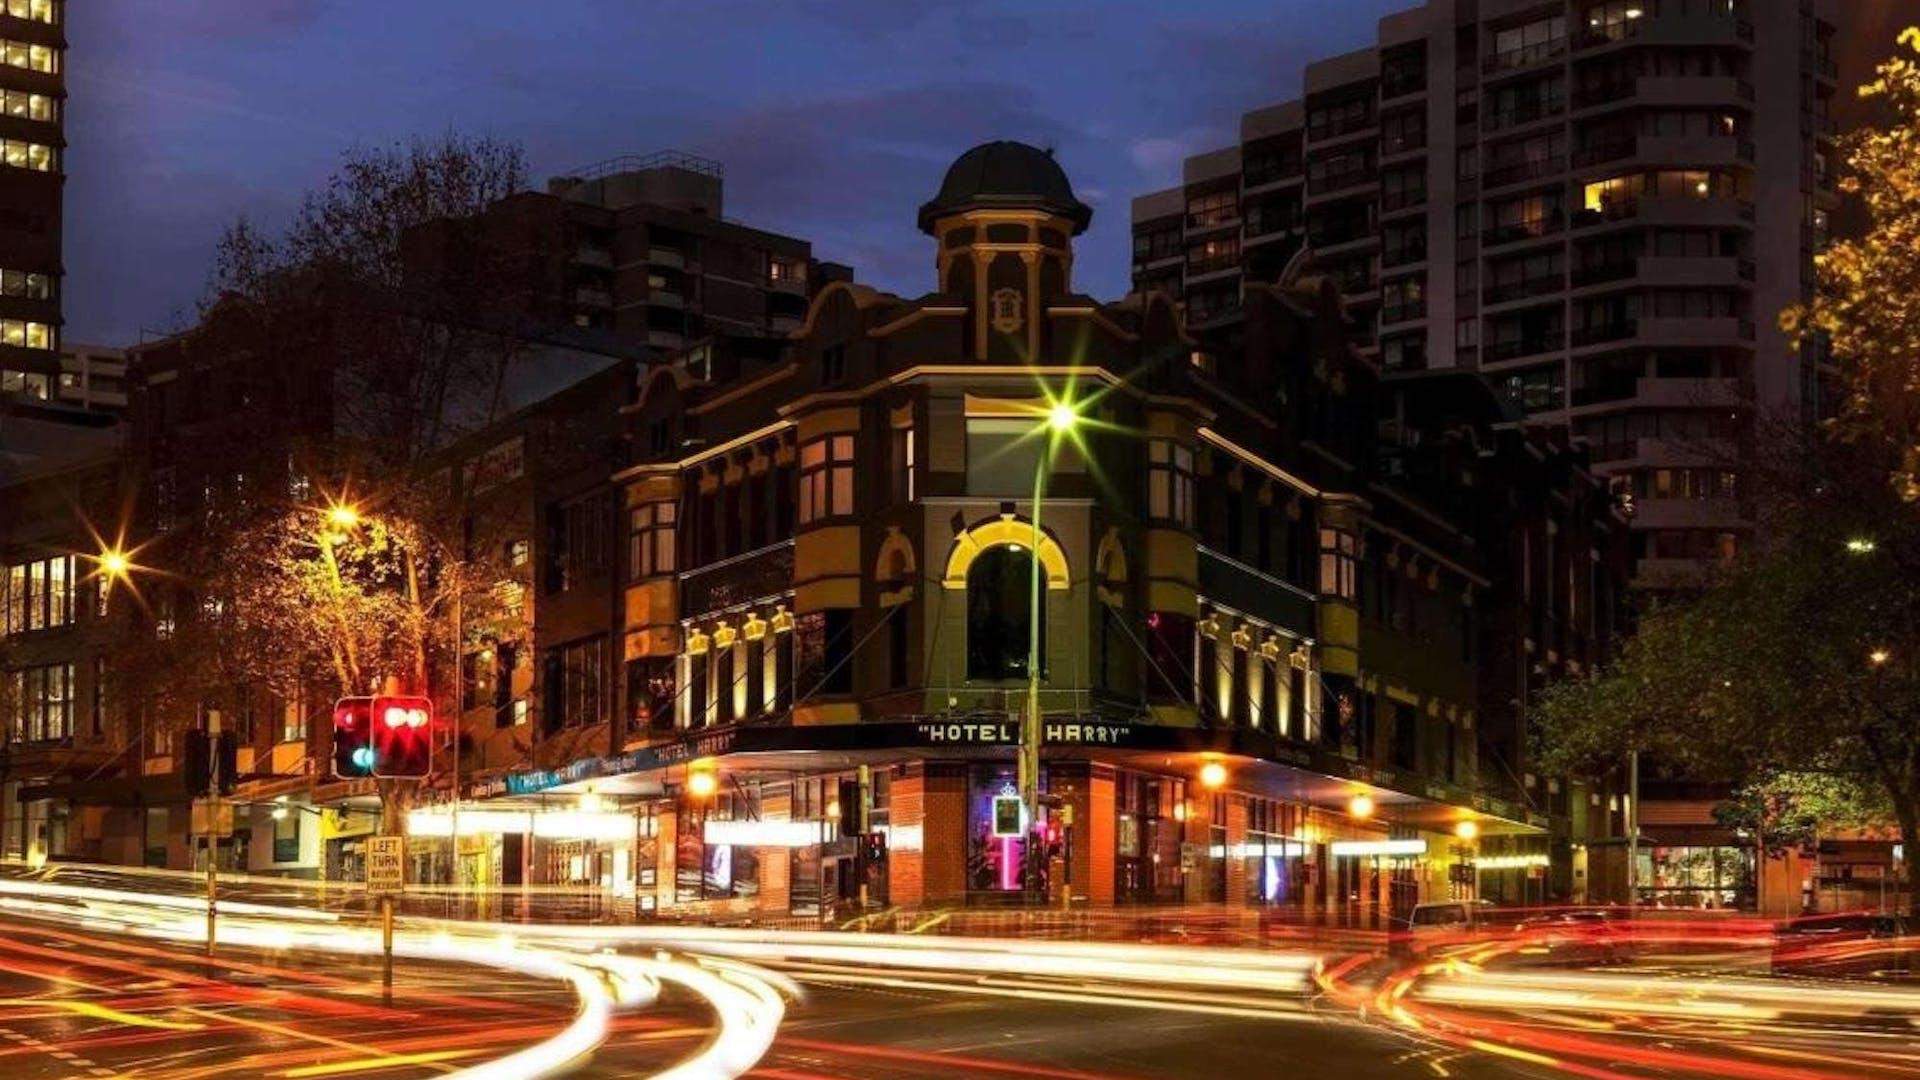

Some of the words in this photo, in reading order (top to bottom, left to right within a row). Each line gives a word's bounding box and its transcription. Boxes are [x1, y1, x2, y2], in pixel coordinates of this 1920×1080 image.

[918, 724, 1011, 741] "HOTEL
[1047, 724, 1129, 742] HARRY"
[372, 840, 396, 852] LEFT
[372, 856, 399, 867] TURN
